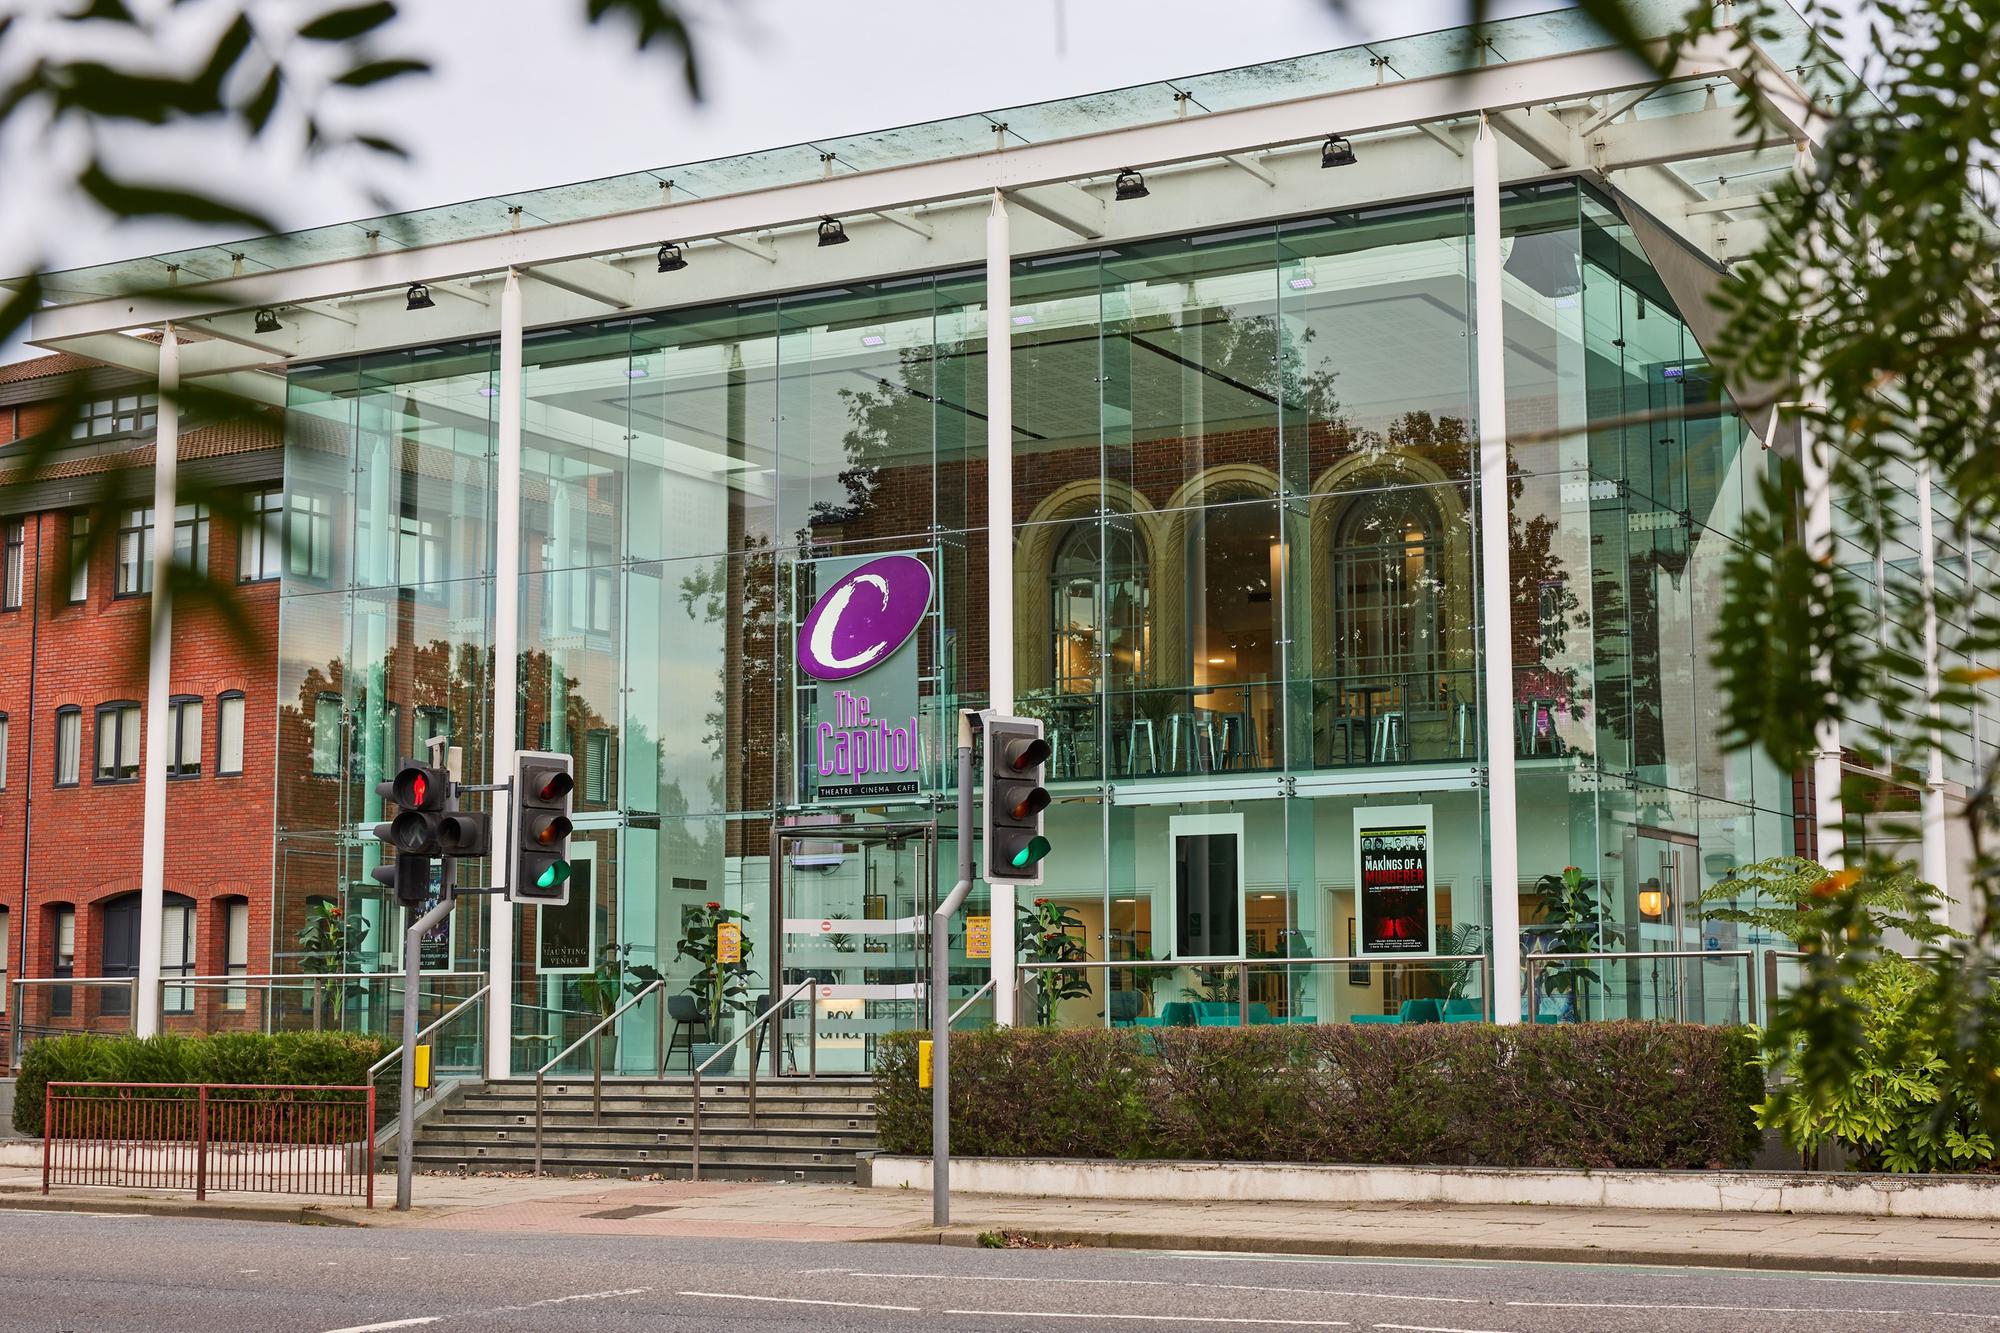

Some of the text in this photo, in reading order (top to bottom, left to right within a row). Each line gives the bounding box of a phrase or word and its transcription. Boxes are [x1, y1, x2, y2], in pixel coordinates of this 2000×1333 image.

[833, 690, 870, 728] The
[817, 716, 919, 784] Capitol
[820, 784, 916, 796] THEATRE CINEMA CAFE
[1365, 855, 1423, 871] MAKINGS OF A
[1365, 869, 1425, 884] MURDERER
[543, 948, 587, 956] HAUNTING
[550, 957, 579, 965] VENICE
